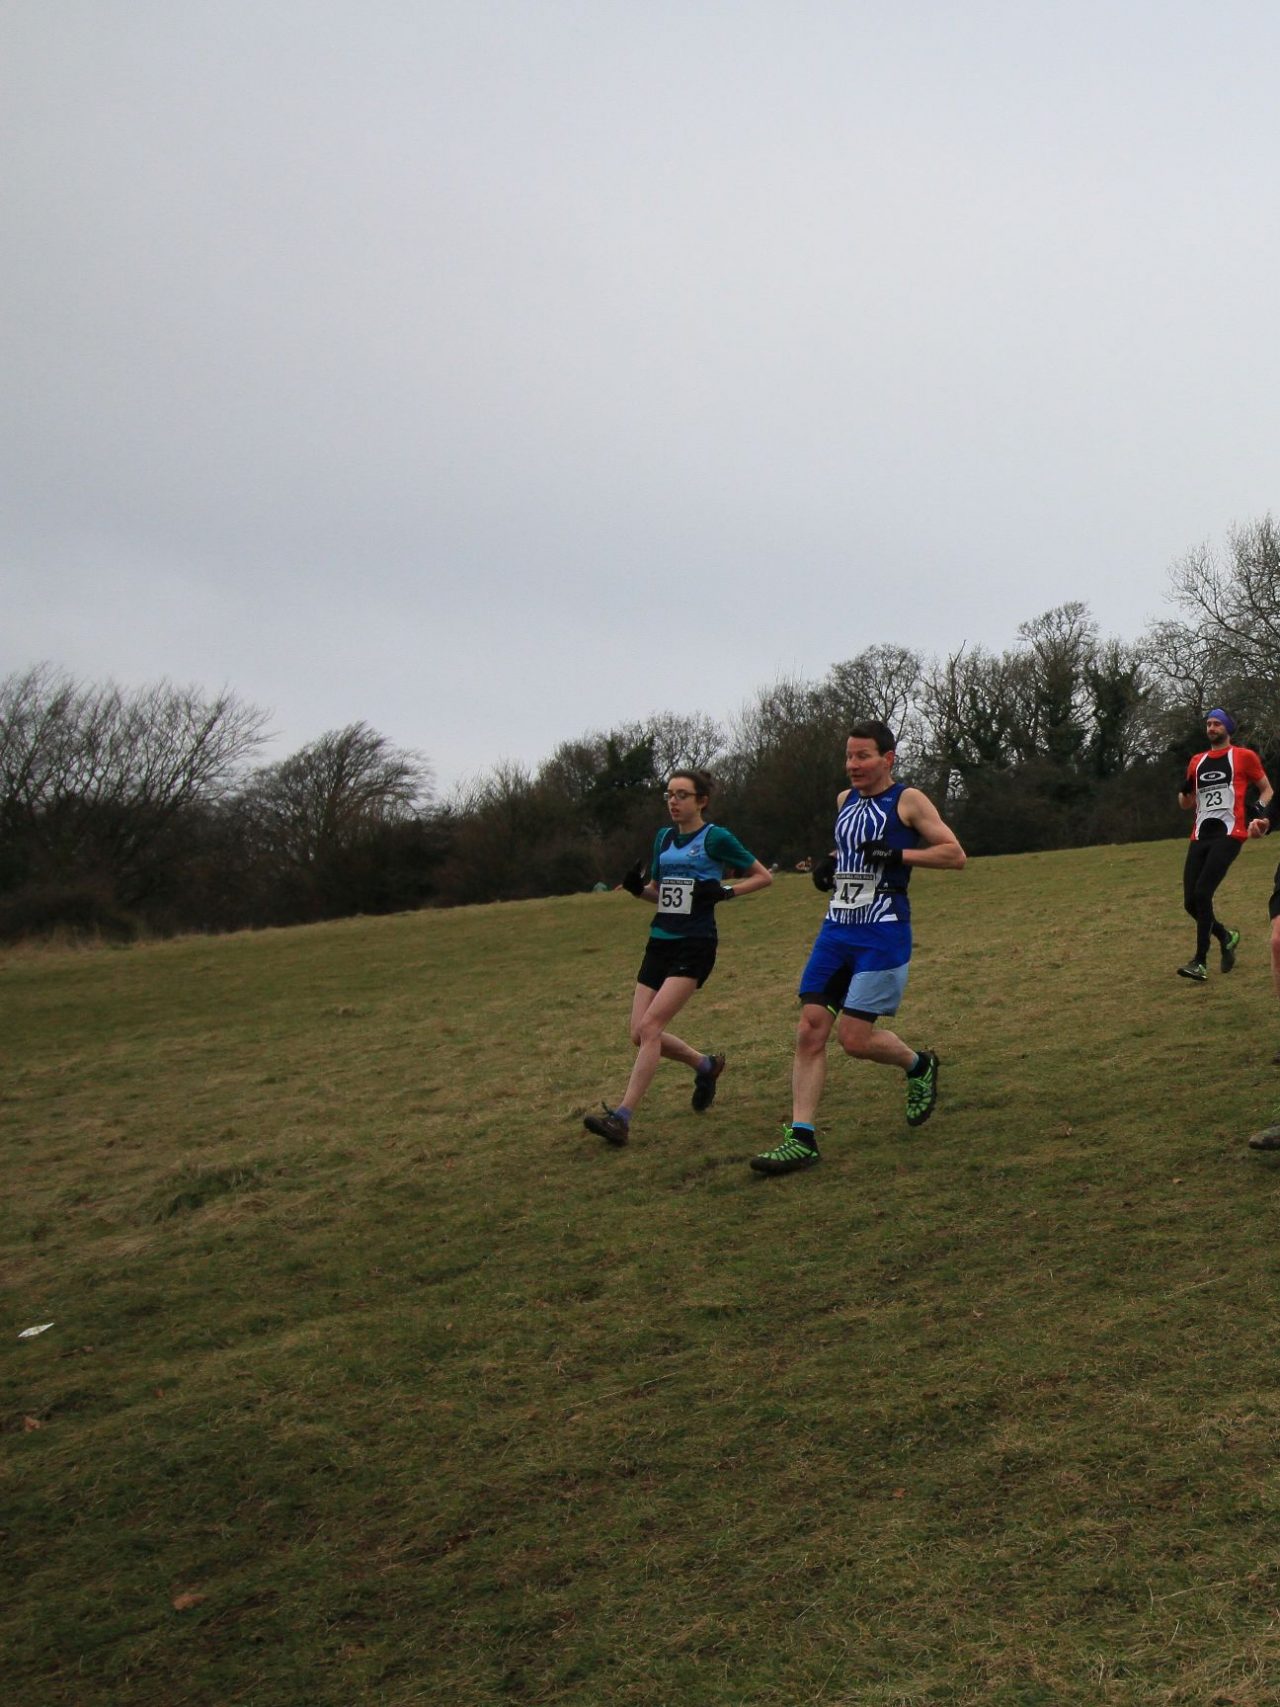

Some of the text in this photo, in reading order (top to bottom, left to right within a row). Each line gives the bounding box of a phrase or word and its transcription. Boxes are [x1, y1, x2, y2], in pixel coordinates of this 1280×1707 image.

[1205, 791, 1222, 807] 23
[662, 887, 683, 908] 53
[840, 883, 864, 904] 47
